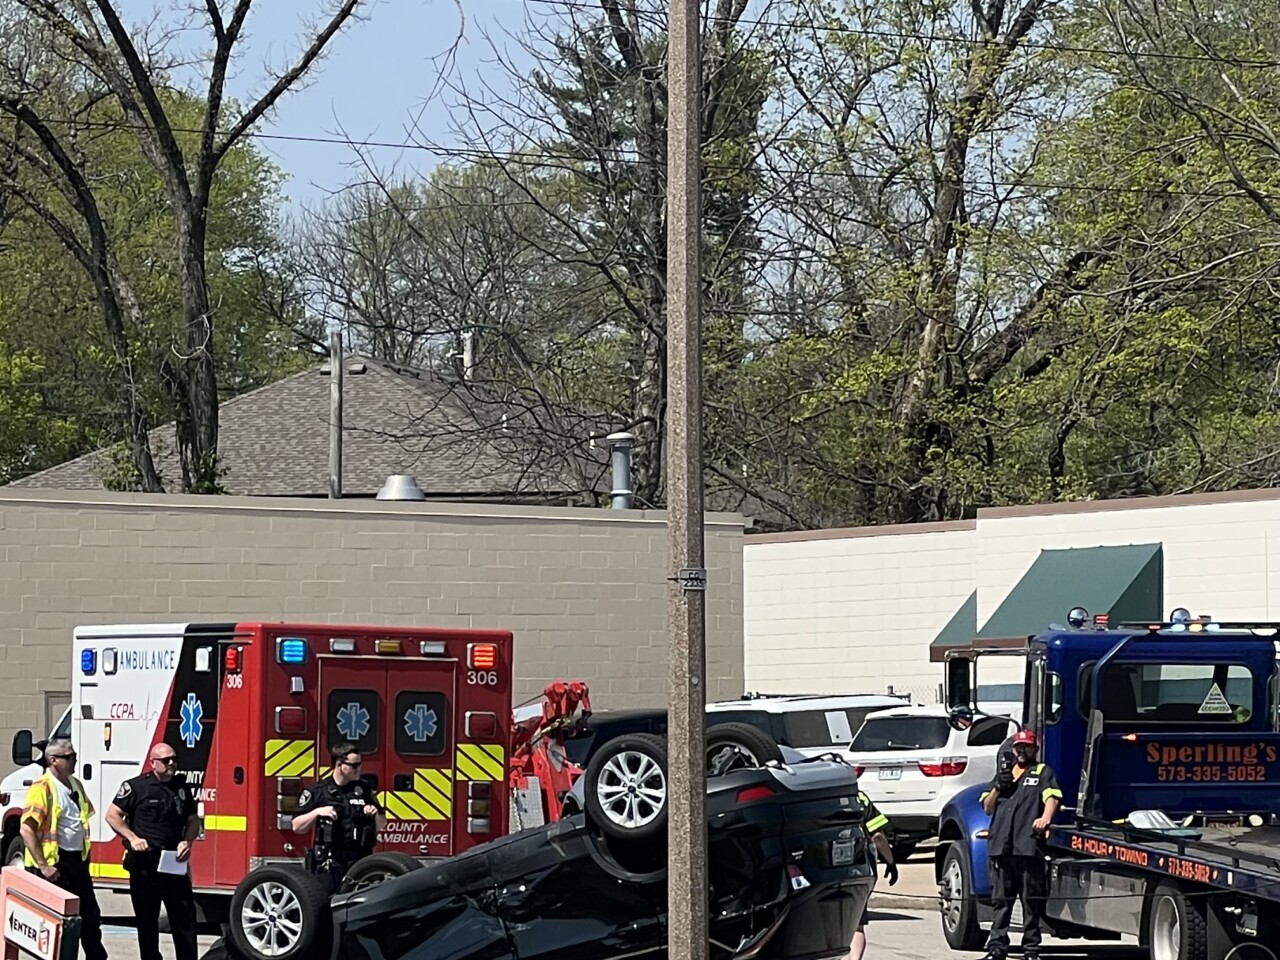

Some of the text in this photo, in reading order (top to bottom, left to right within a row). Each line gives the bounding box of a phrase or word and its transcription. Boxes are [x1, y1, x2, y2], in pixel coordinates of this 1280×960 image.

[119, 650, 175, 670] AMBULANCE
[226, 674, 243, 689] 306
[466, 671, 498, 685] 306
[110, 703, 135, 719] CCPA
[1147, 742, 1277, 765] Sperling's
[1158, 766, 1265, 781] 573-335-5052
[380, 822, 429, 832] OUNTY
[1071, 835, 1083, 850] 24
[1084, 839, 1108, 856] HOUR
[13, 918, 38, 943] ENTER
